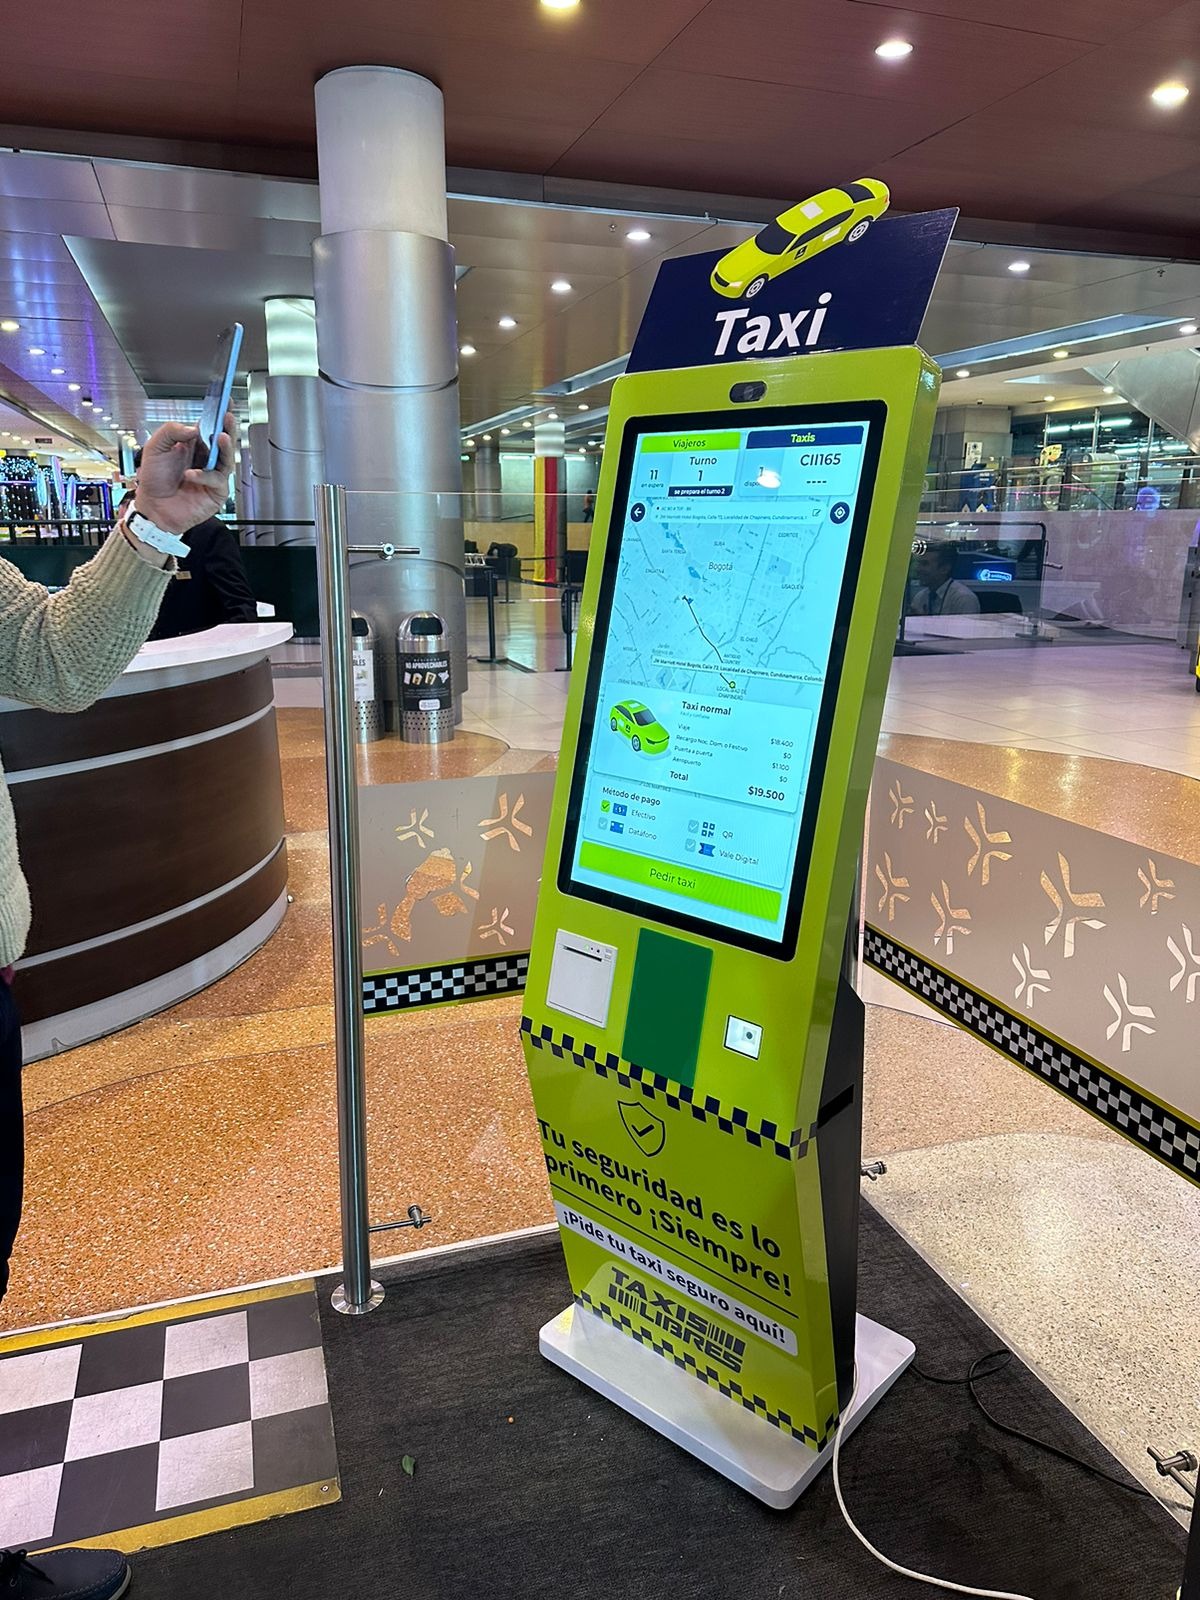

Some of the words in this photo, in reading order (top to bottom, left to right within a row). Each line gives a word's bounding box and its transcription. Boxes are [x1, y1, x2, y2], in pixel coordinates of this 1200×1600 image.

[714, 291, 832, 356] Taxi
[673, 439, 706, 449] Viajeros
[791, 432, 815, 443] Taxis
[690, 456, 717, 465] Turno
[650, 469, 658, 480] 11
[698, 470, 703, 481] 1
[708, 561, 733, 572] Bogotá
[682, 701, 699, 710] Taxi
[700, 705, 731, 715] normal
[678, 723, 690, 731] Viaje
[674, 745, 691, 753] Puerta
[676, 735, 697, 743] Recargo
[729, 744, 748, 752] Festivo
[672, 756, 701, 766] Aeropuerto
[670, 771, 689, 781] Total
[602, 787, 629, 799] Método
[631, 793, 640, 801] de
[641, 796, 661, 806] pago
[748, 786, 785, 801] $19.500
[631, 809, 656, 821] Efectivo
[722, 830, 733, 839] QR
[719, 850, 734, 859] Vale
[735, 853, 759, 865] Digital
[650, 868, 675, 883] Pedir
[677, 876, 696, 889] taxi
[538, 1118, 566, 1150] Tu
[572, 1137, 703, 1220] seguridad
[711, 1213, 744, 1241] es
[752, 1223, 781, 1258] lo
[544, 1152, 642, 1217] primero
[650, 1208, 792, 1297] ¡Siempre!
[564, 1210, 604, 1242] ¡Pide
[607, 1233, 626, 1254] tu
[629, 1245, 662, 1275] taxi
[667, 1268, 730, 1312] seguro
[734, 1305, 785, 1344] aquí!
[610, 1266, 708, 1334] TAXIS
[640, 1300, 744, 1373] LIBRES
